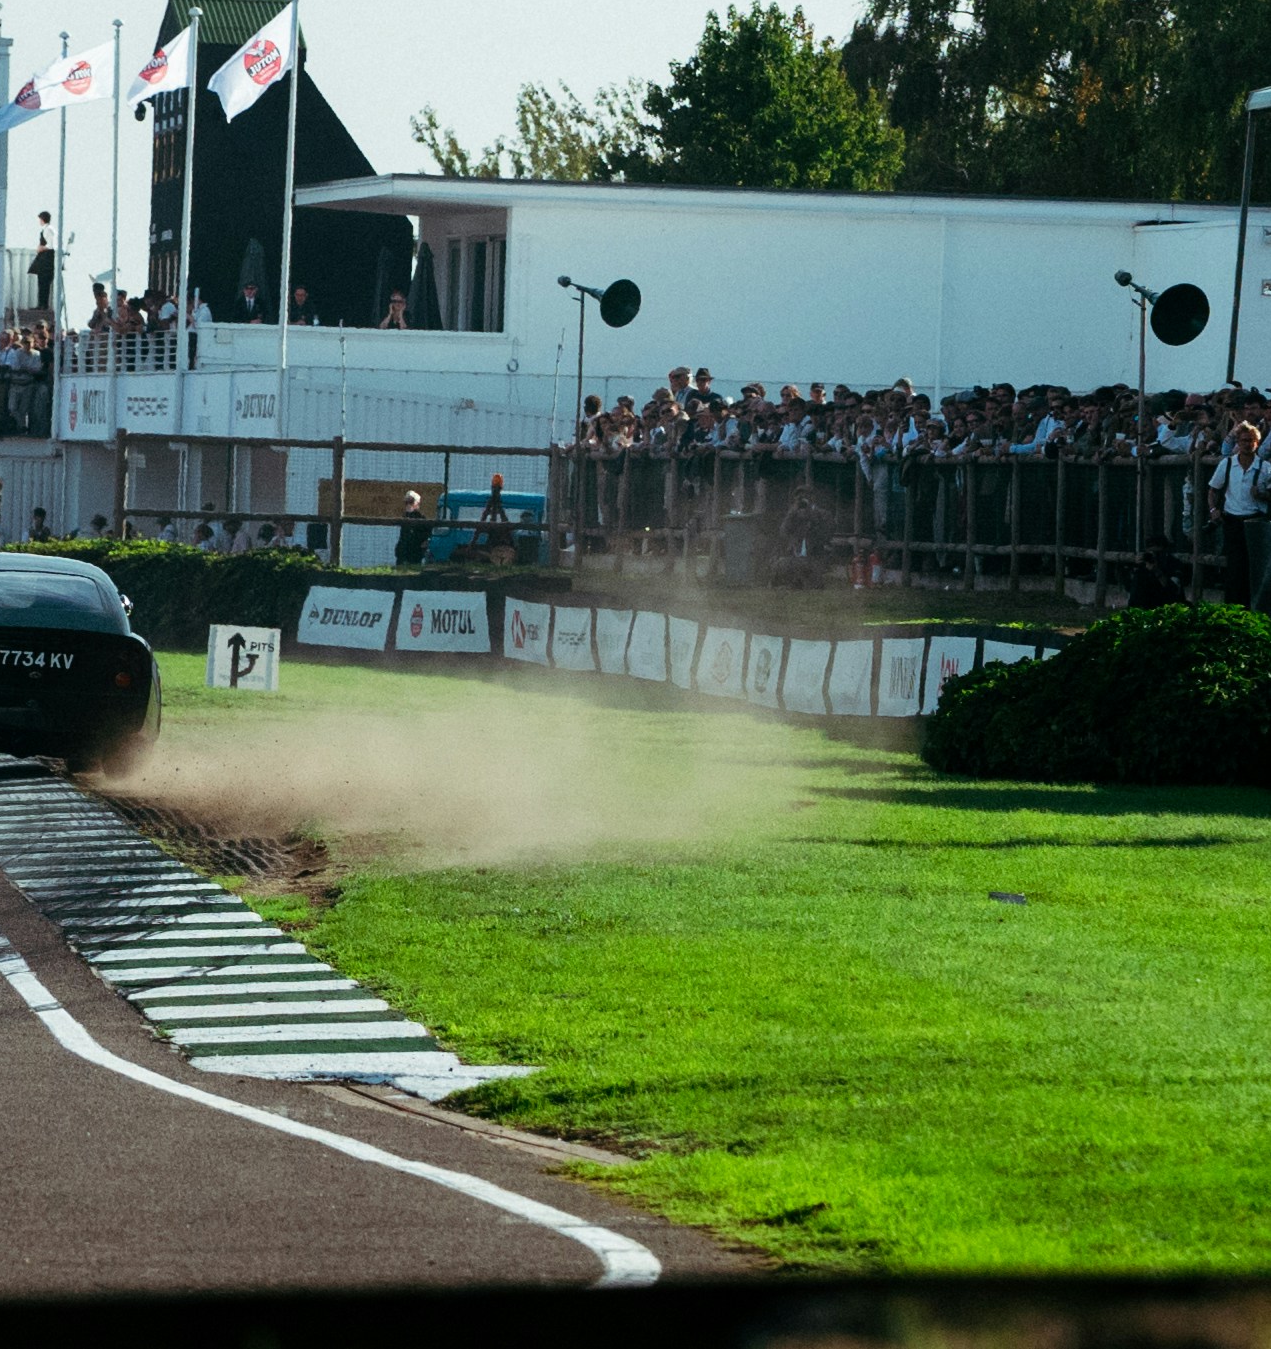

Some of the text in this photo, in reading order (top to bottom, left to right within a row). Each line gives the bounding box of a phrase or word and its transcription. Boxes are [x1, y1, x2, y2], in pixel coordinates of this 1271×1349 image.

[241, 393, 276, 419] DUNLO
[319, 607, 383, 629] DUNLOP
[431, 609, 476, 635] MOTUL
[249, 641, 275, 653] PITS
[0, 649, 74, 670] 7734 KV
